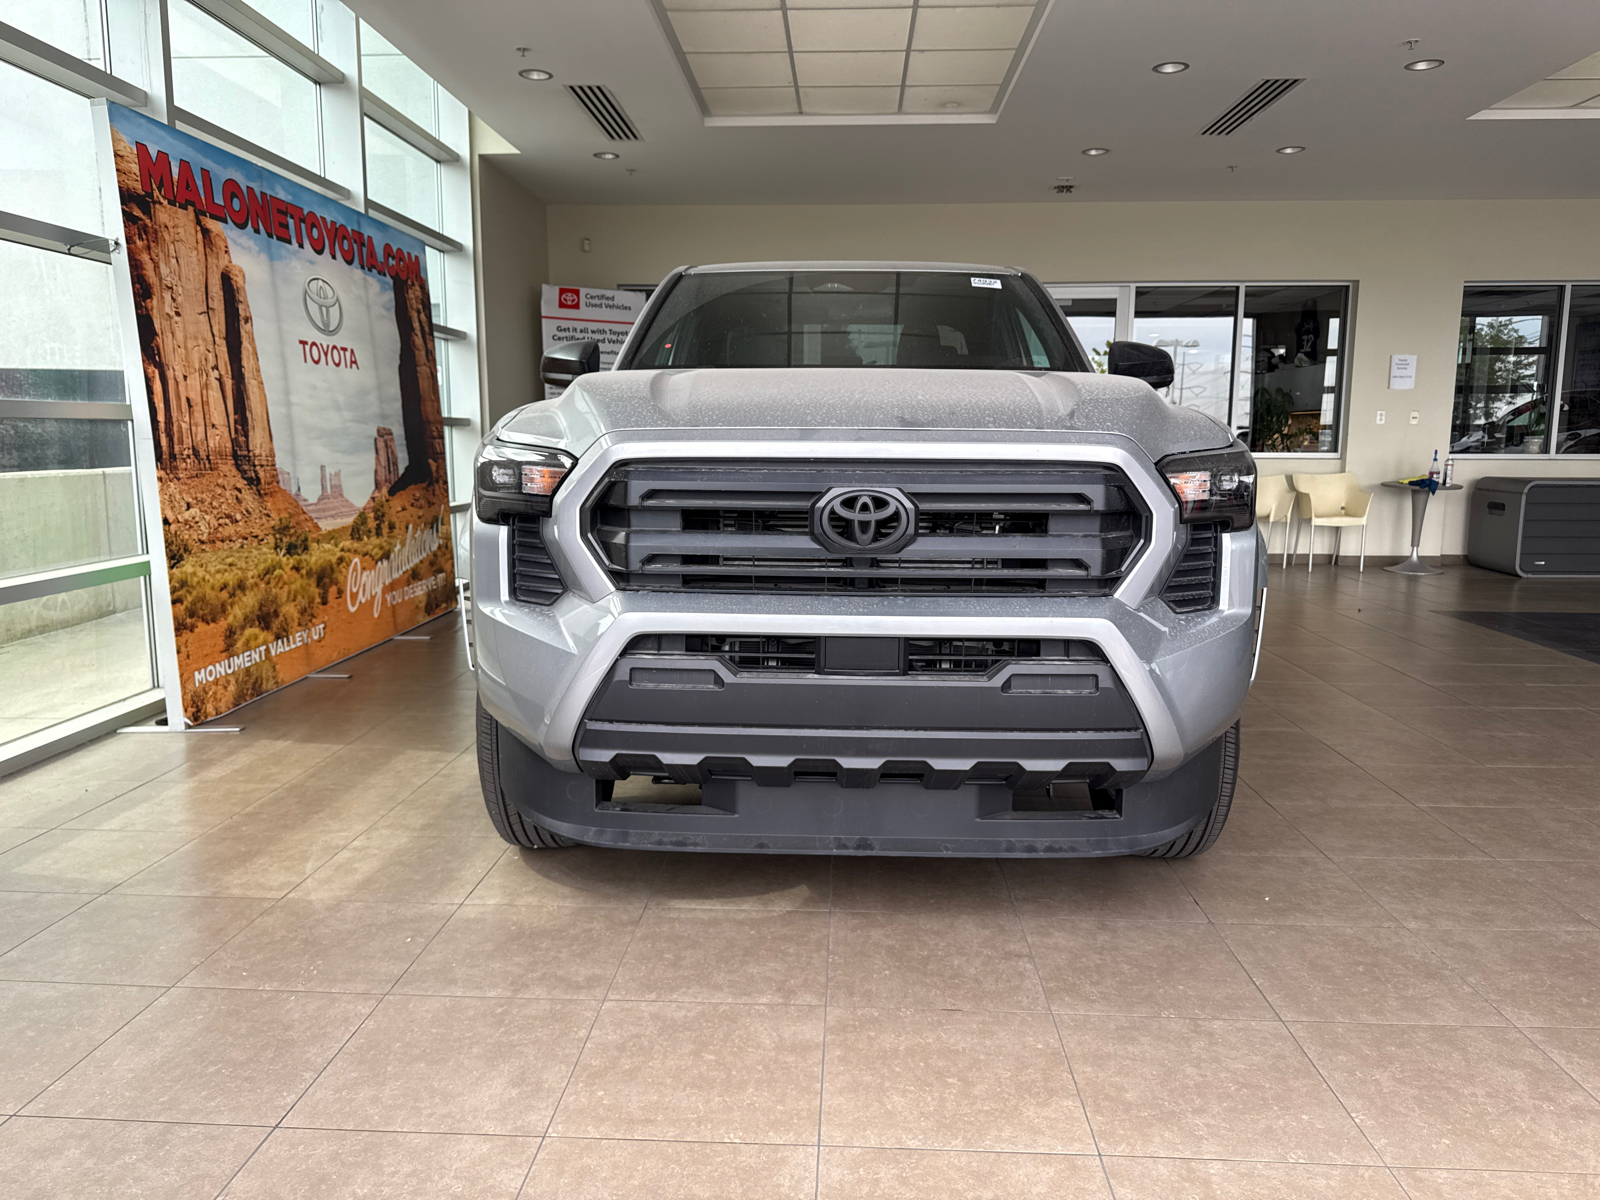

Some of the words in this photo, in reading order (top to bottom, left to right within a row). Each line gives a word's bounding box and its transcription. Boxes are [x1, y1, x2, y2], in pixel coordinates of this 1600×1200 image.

[136, 141, 423, 283] MALONETOYOTA.COM
[585, 293, 615, 302] Certified
[585, 301, 603, 309] Used
[605, 303, 632, 311] Vehicles
[579, 327, 589, 335] all
[591, 328, 607, 336] with
[609, 328, 629, 338] Toyot
[299, 339, 359, 370] TOYOTA
[347, 504, 444, 618] Congratulations!
[386, 591, 403, 607] YOU
[404, 576, 438, 601] DESERVE
[194, 644, 267, 687] MONUMENT
[269, 629, 311, 657] VALLEY,
[311, 623, 325, 640] UT
